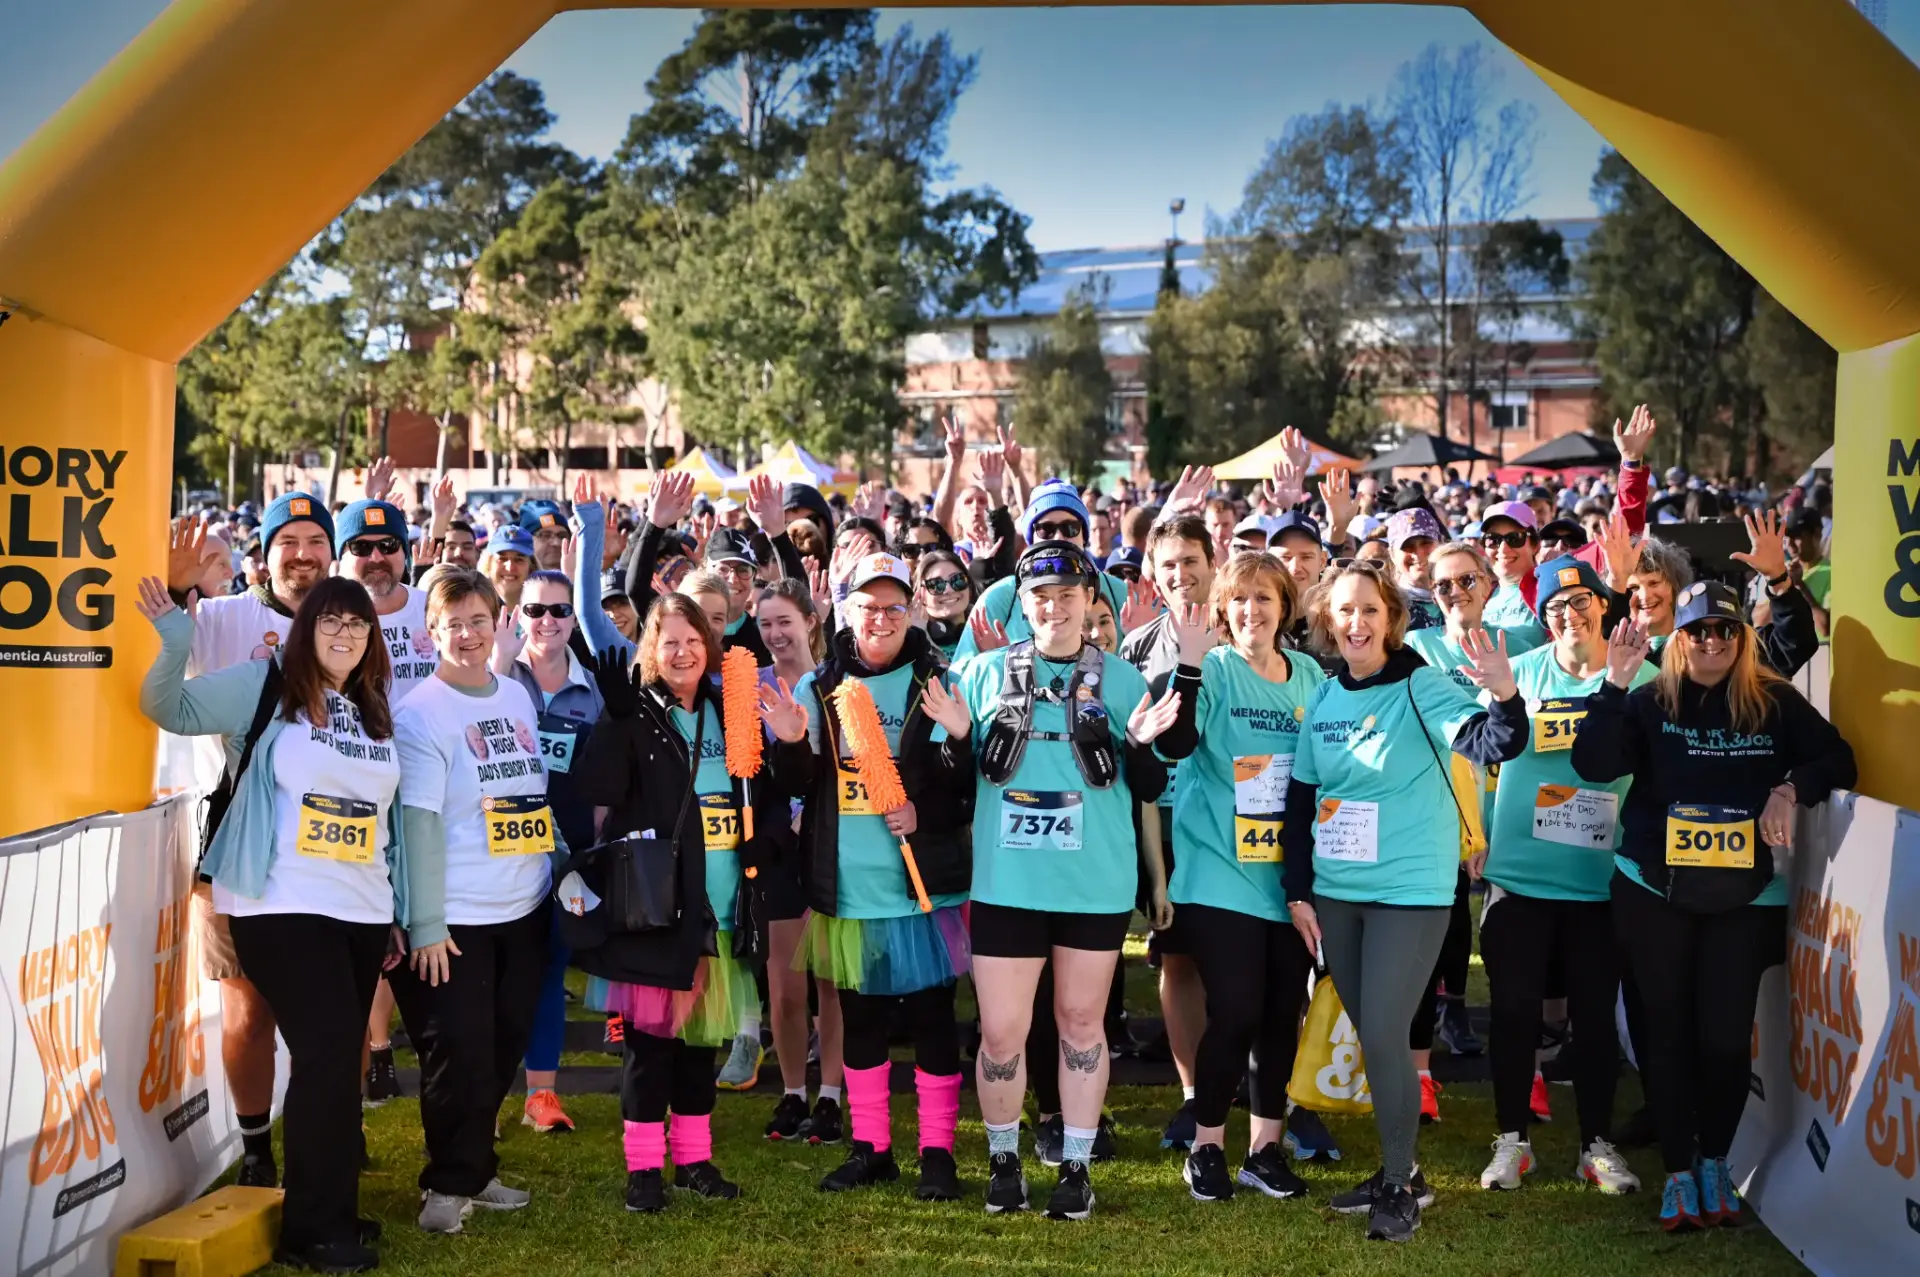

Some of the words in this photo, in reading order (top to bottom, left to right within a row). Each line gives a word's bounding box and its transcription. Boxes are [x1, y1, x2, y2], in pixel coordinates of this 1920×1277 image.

[0, 445, 128, 499] ORY
[0, 494, 116, 559] LK
[402, 626, 411, 640] &
[0, 650, 39, 662] entia
[43, 651, 104, 662] Australia
[333, 716, 360, 738] HUH
[505, 718, 515, 733] &
[1230, 708, 1287, 723] MEMORY
[1312, 721, 1357, 735] MEMORY
[311, 727, 334, 747] DAD'S
[335, 737, 367, 760] MEMORY
[368, 745, 391, 763] ARMY
[490, 736, 518, 755] HUGH
[477, 764, 501, 783] DAD'S
[498, 758, 528, 779] MEMORY
[1547, 809, 1571, 820] STEVE
[1578, 804, 1597, 816] DAD
[307, 819, 367, 848] 3861
[493, 818, 547, 841] 3860
[1009, 813, 1074, 836] 7374
[1544, 819, 1560, 828] LOVE
[1563, 821, 1577, 830] YOU
[1675, 829, 1746, 852] 3010
[20, 923, 112, 1005] MEMORY
[27, 982, 102, 1080] WALK
[28, 1068, 116, 1186] &JOG
